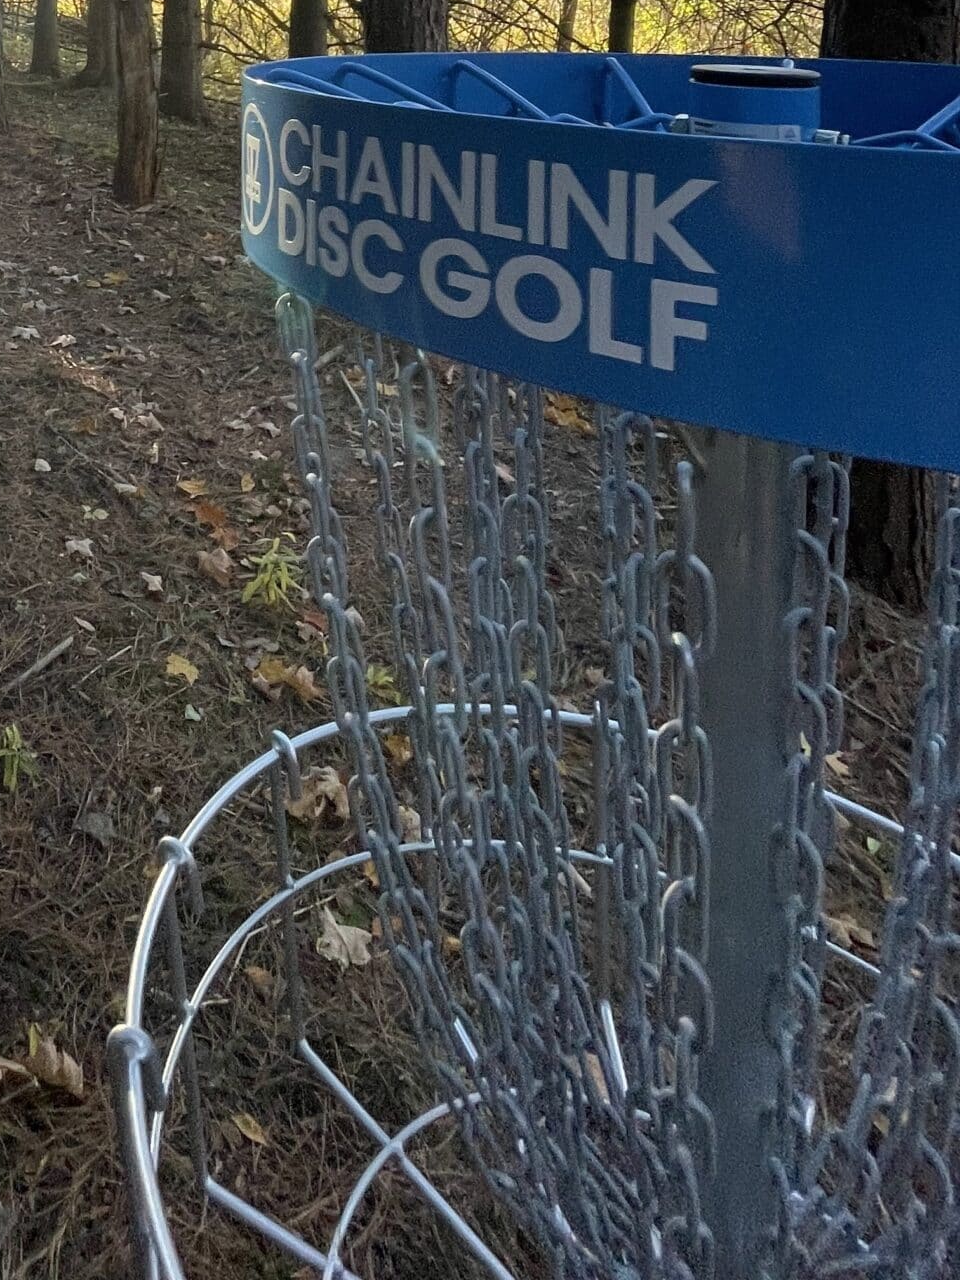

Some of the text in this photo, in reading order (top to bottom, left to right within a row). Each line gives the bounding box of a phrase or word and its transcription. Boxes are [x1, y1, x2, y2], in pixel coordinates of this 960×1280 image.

[278, 187, 719, 372] DISC GOLF
[279, 118, 720, 274] CHAINLINK
